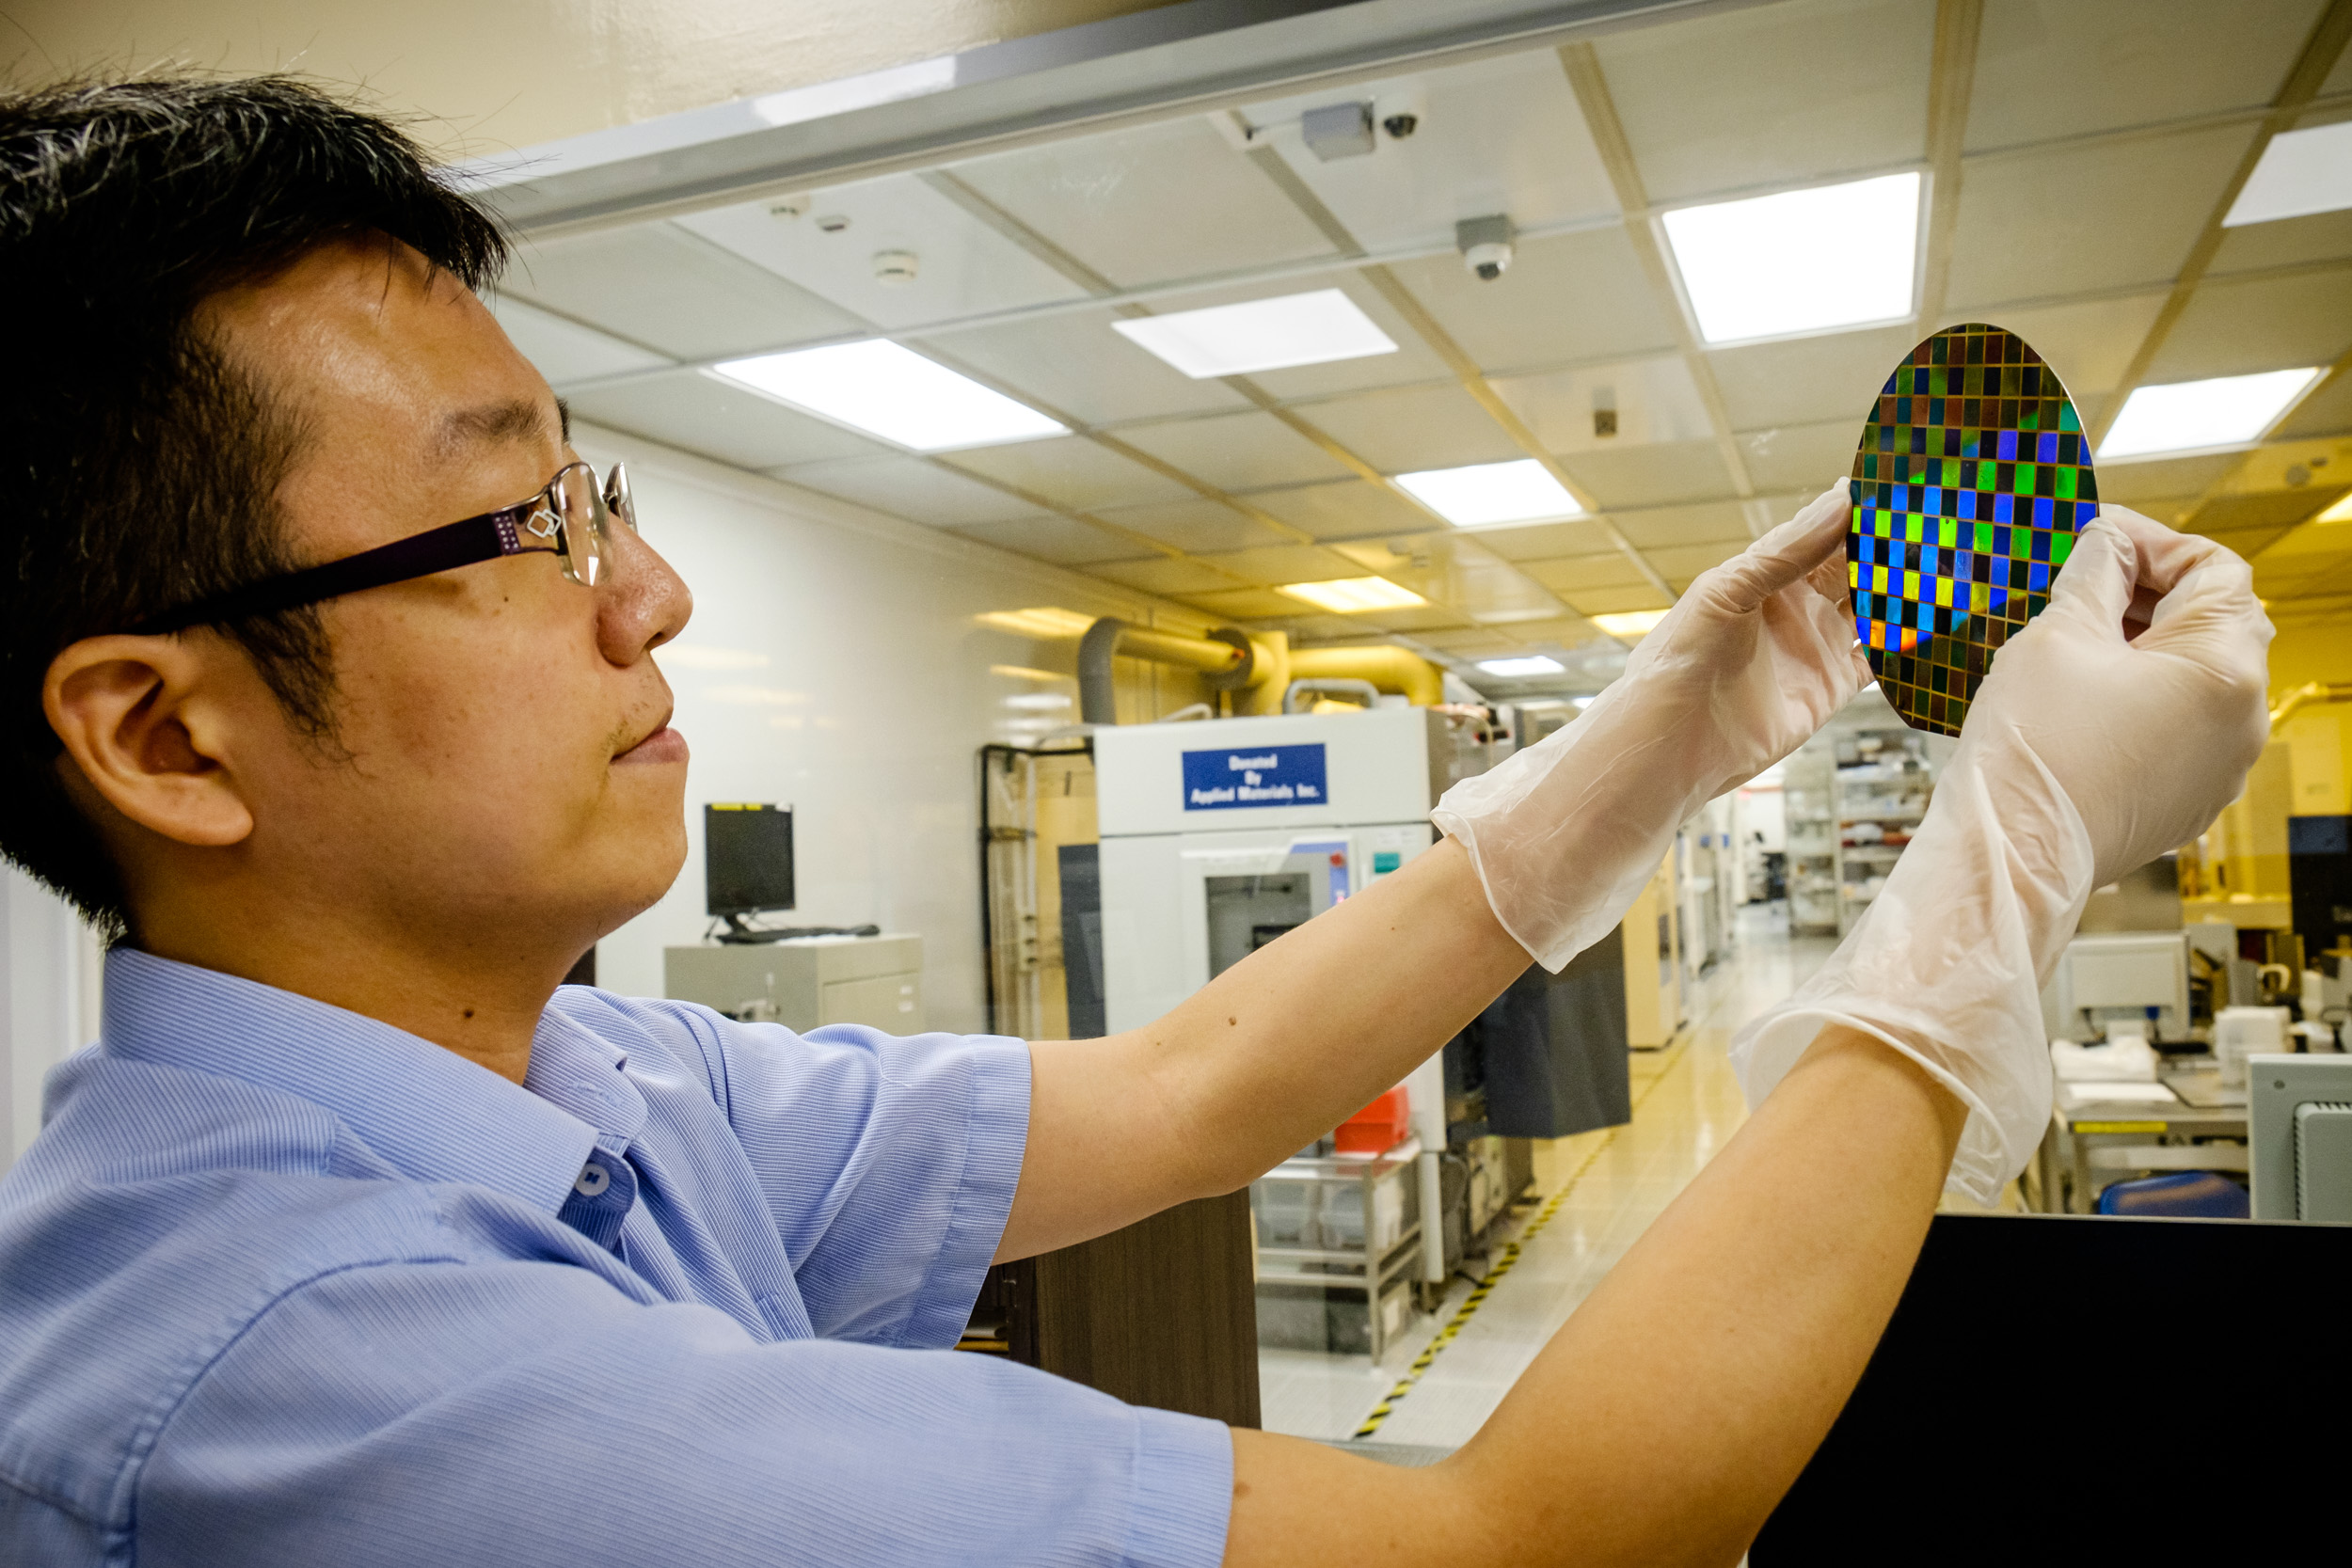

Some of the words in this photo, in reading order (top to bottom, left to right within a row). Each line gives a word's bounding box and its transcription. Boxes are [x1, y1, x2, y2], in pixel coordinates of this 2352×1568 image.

[1228, 753, 1278, 770] Donated
[1244, 770, 1263, 786] By
[1190, 787, 1235, 805] Applied
[1237, 784, 1295, 800] Materials
[1296, 783, 1320, 798] Inc.
